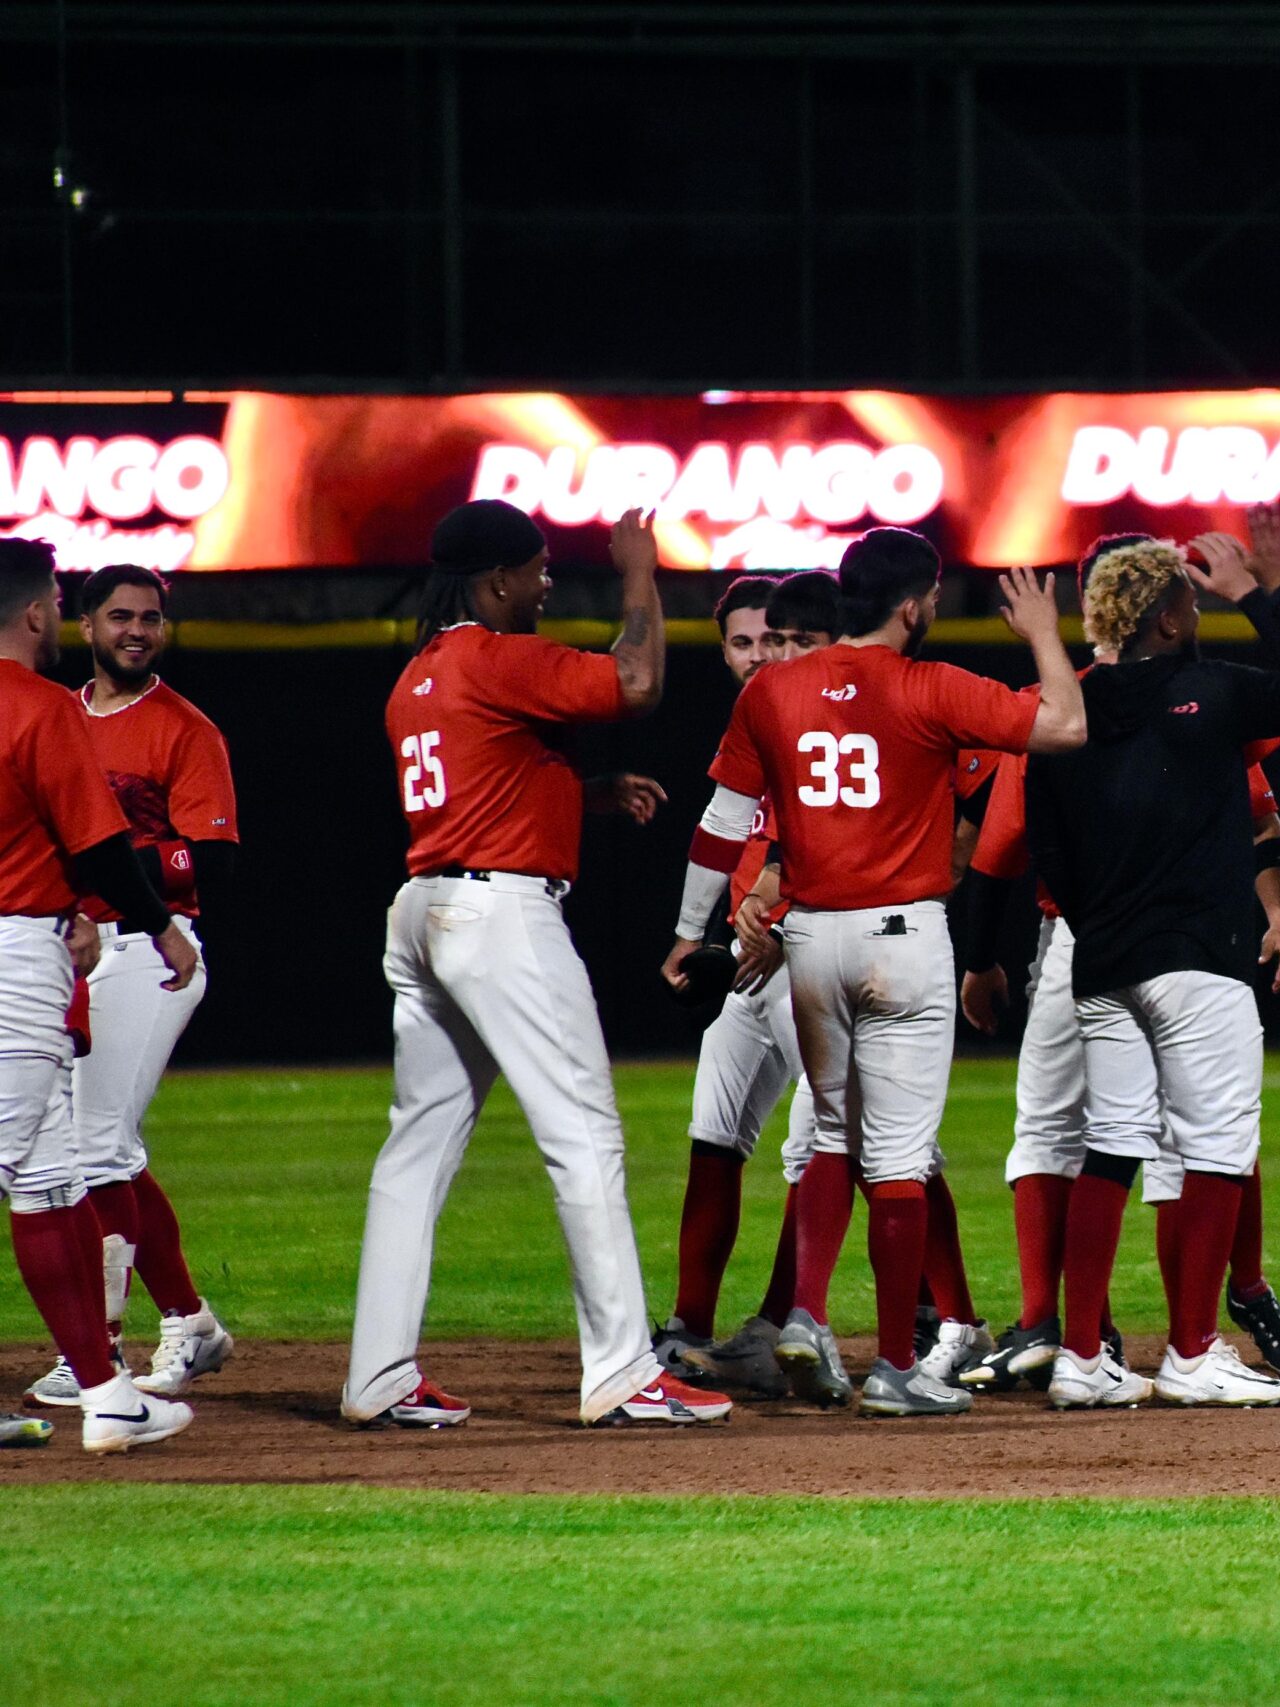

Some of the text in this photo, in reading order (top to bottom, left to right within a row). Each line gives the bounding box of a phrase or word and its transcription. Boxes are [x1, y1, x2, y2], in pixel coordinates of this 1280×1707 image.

[471, 441, 944, 524] DURANGO
[401, 730, 446, 812] 25
[797, 731, 880, 808] 33
